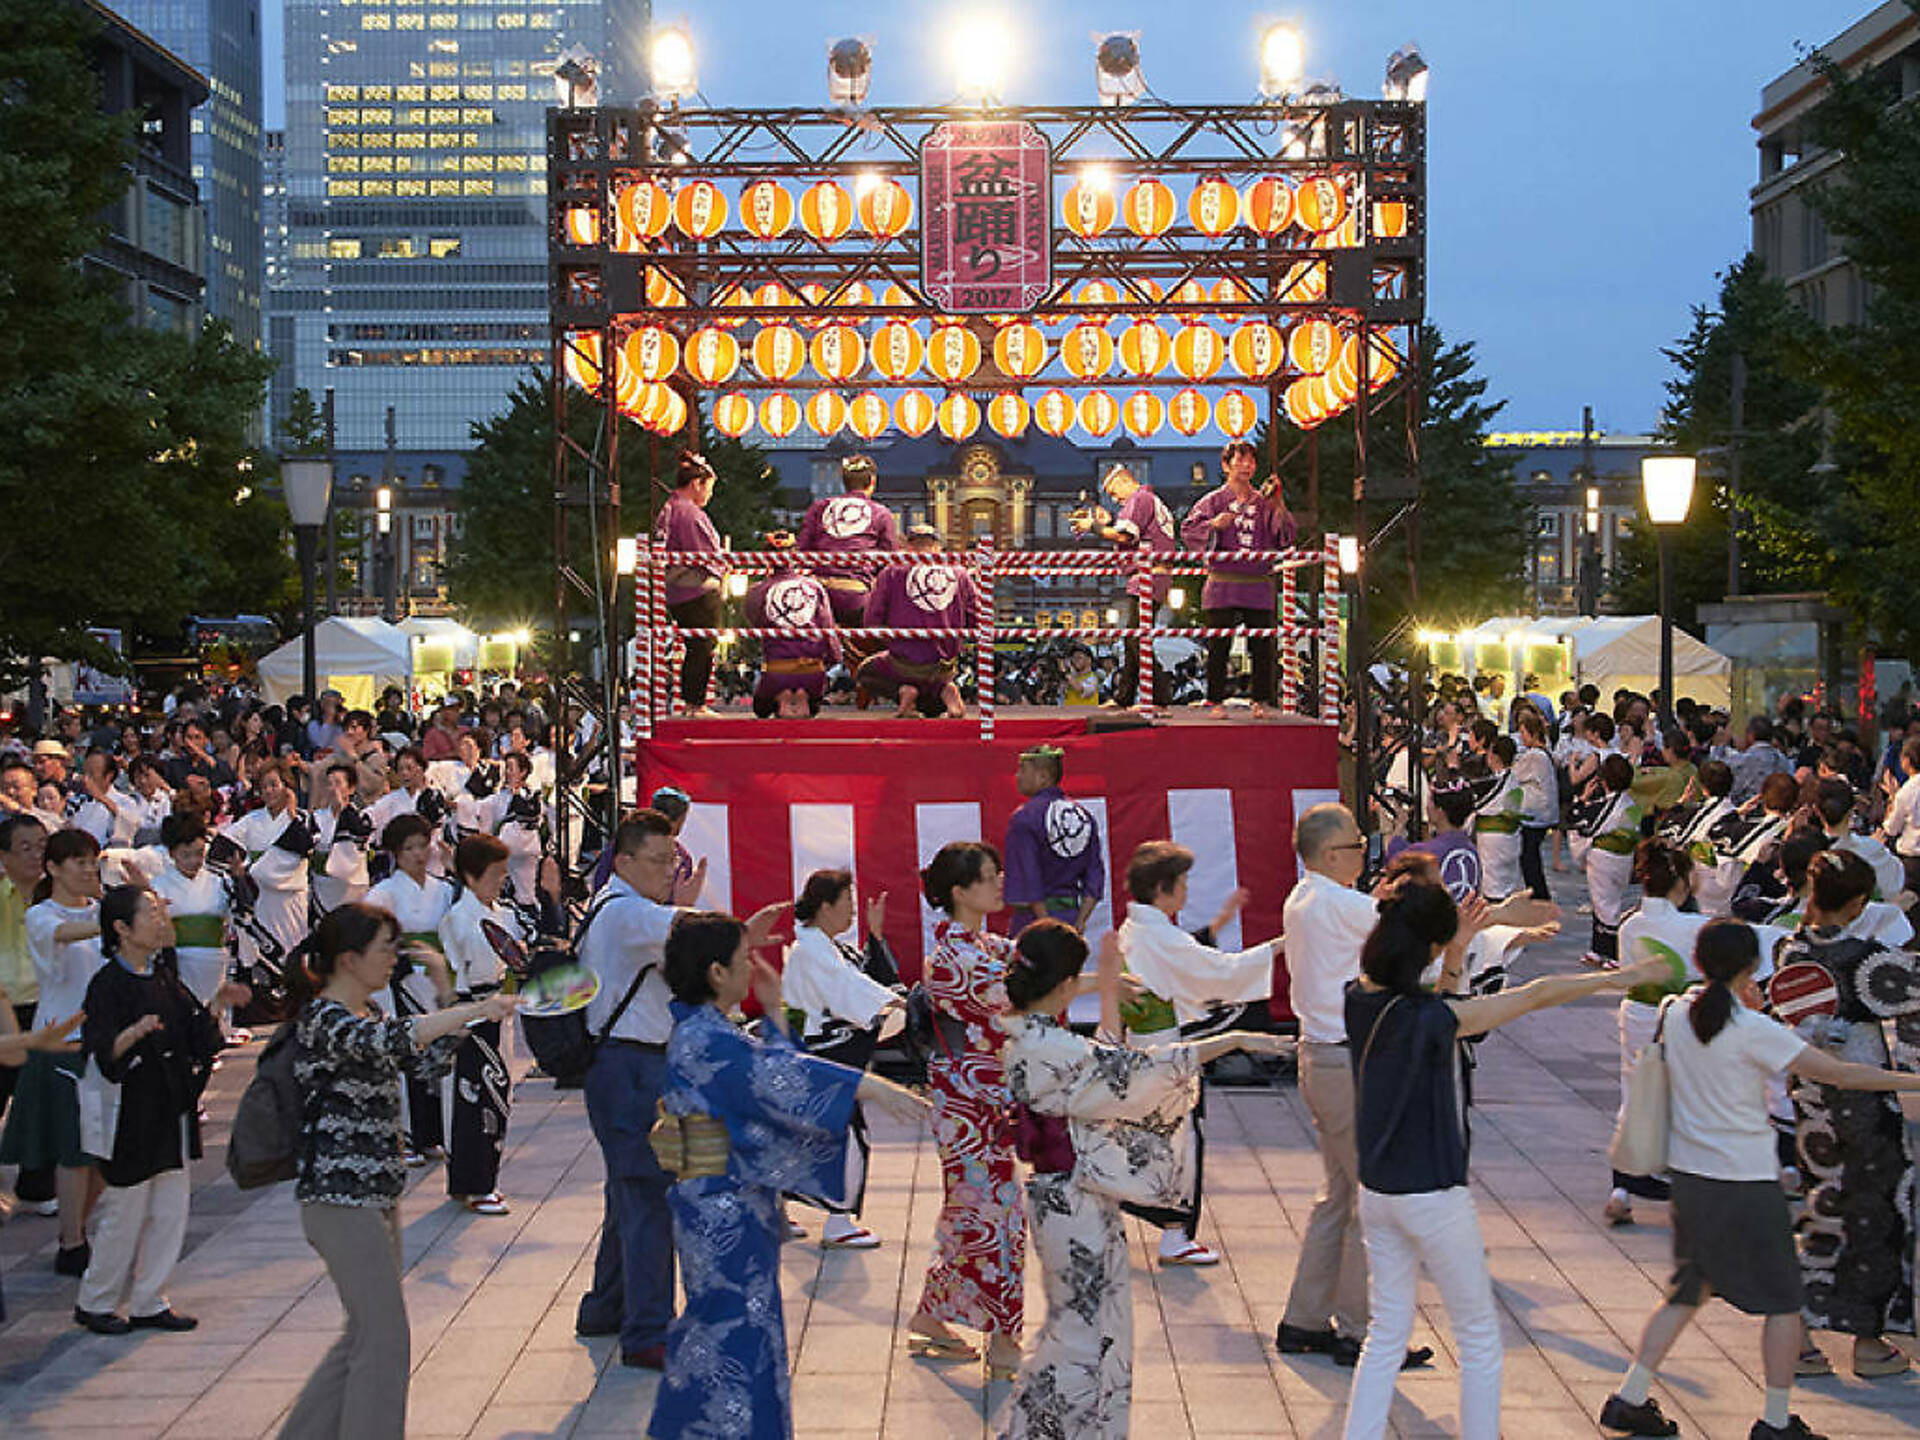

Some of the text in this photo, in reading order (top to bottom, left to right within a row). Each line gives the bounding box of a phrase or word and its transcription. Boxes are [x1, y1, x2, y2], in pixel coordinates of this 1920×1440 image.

[953, 155, 1019, 281] 盆踊り
[961, 289, 1012, 308] 2017
